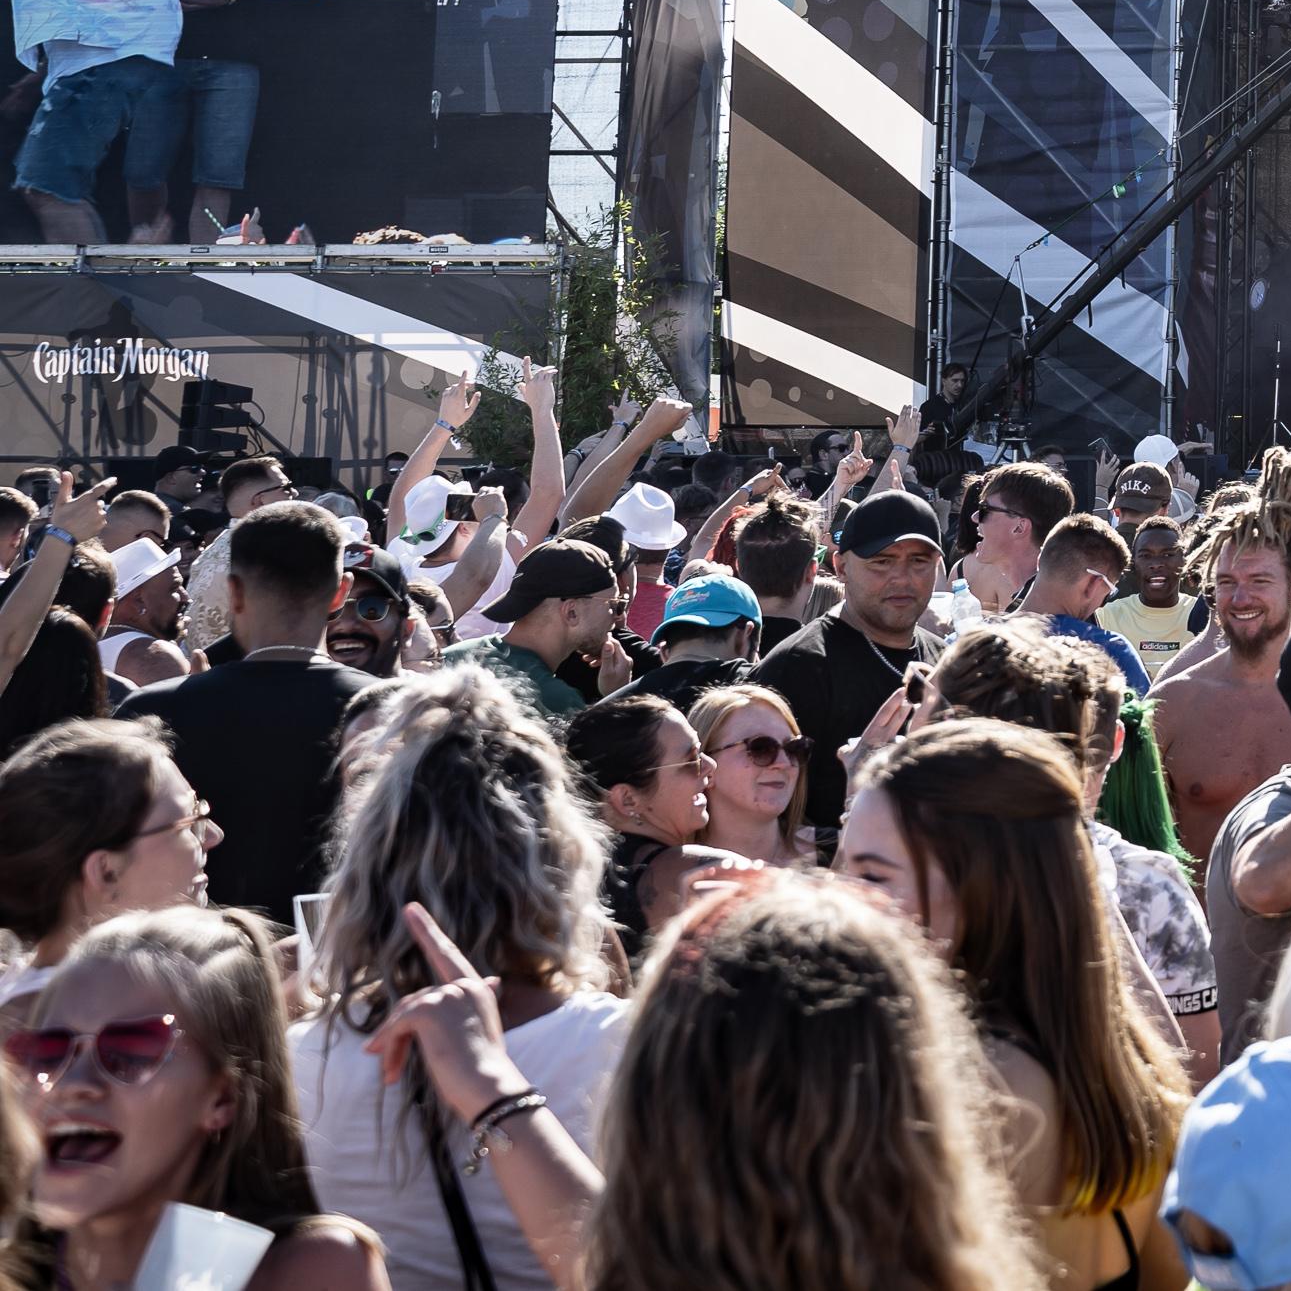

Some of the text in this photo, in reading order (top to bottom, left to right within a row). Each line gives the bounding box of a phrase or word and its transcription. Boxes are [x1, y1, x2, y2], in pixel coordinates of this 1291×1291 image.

[33, 337, 209, 383] Captain Morgan
[1120, 479, 1151, 495] NIKE
[1142, 642, 1168, 650] adidas
